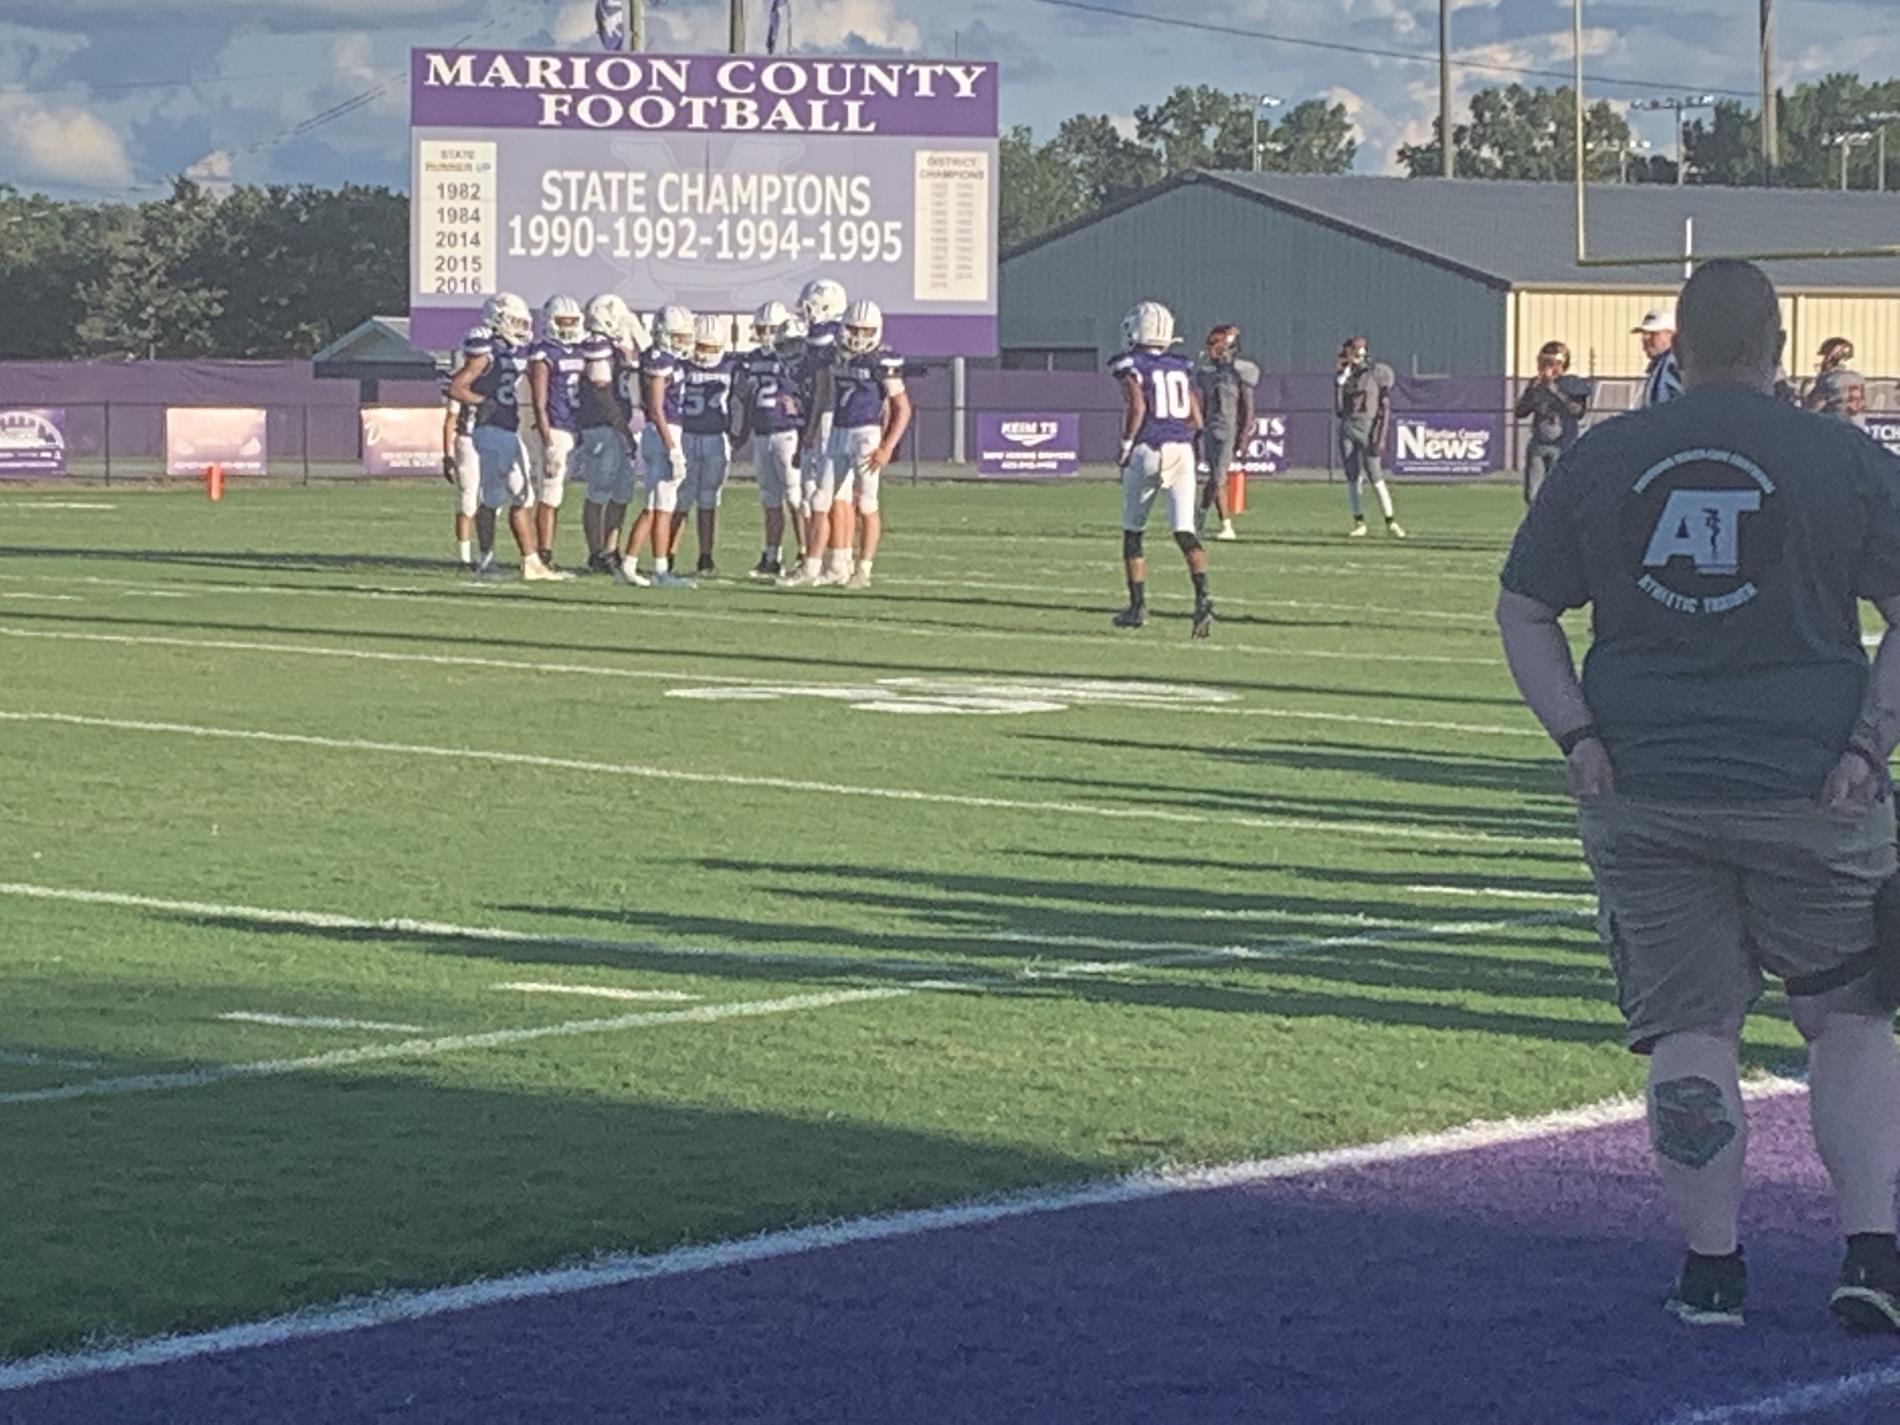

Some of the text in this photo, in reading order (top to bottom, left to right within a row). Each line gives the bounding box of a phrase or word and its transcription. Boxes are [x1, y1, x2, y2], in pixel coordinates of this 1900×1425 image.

[424, 54, 987, 97] MARION COUNTY
[538, 93, 876, 132] FOOTBALL
[440, 149, 475, 160] STATE
[927, 156, 978, 168] DISTRICT
[475, 161, 492, 172] UP
[919, 170, 985, 181] CHAMPIONS
[436, 182, 481, 201] 1982
[541, 169, 872, 217] STATE CHAMPIONS
[436, 207, 481, 225] 1984
[435, 231, 481, 249] 2014
[507, 214, 903, 263] 1990-1992-1994-1995
[435, 255, 483, 273] 2015
[435, 276, 482, 294] 2016
[1152, 369, 1191, 419] 10
[1397, 425, 1486, 460] News
[1643, 489, 1761, 575] AT
